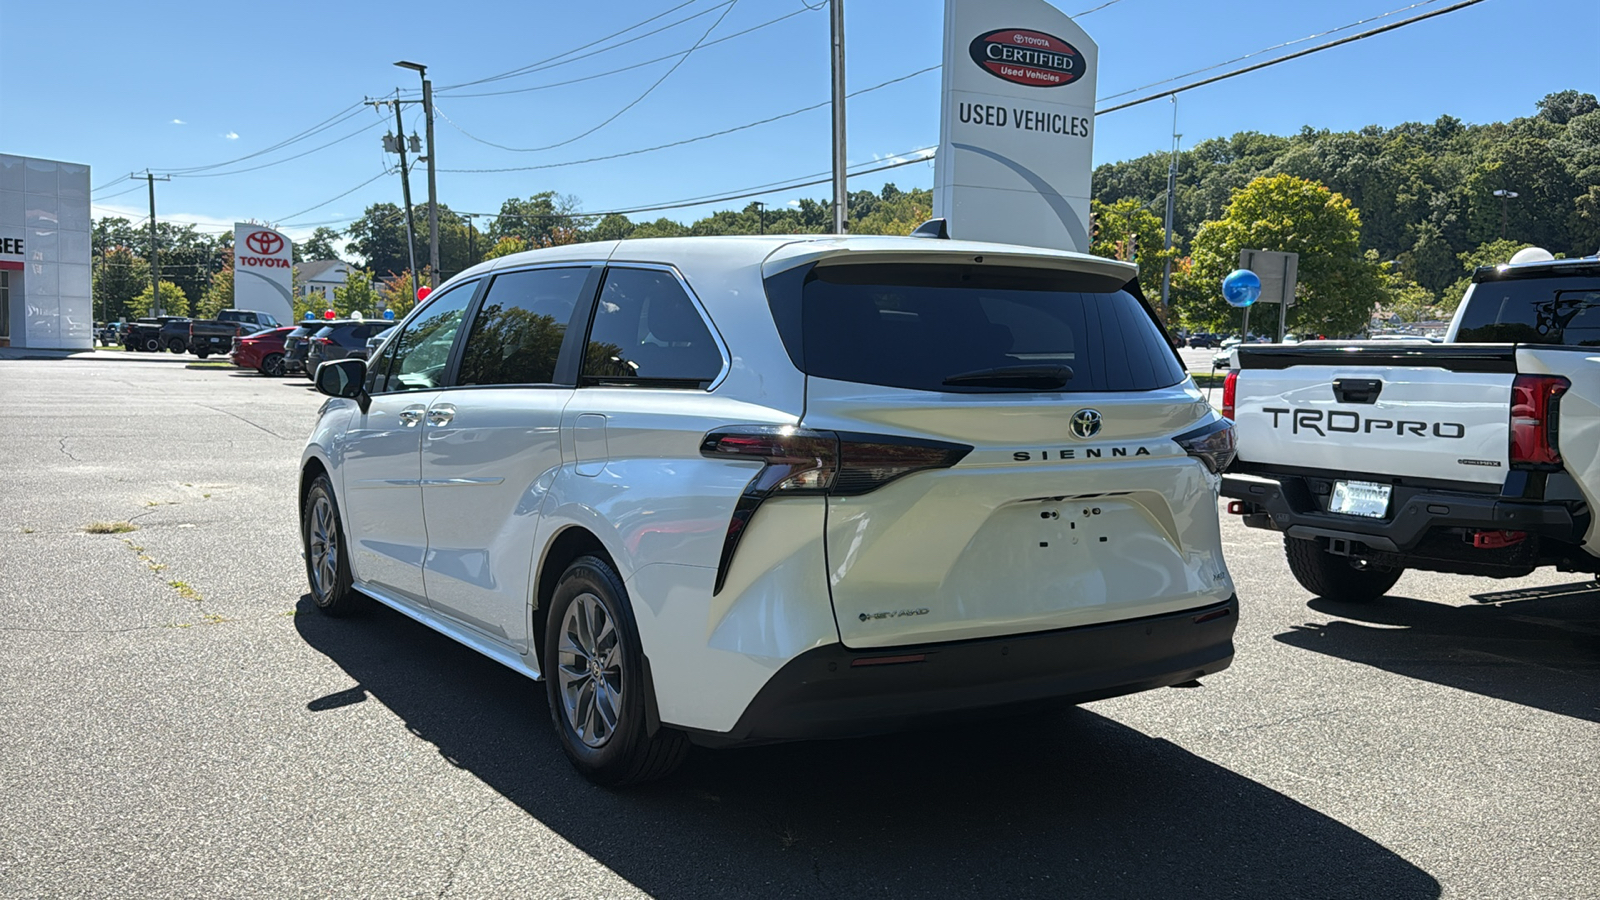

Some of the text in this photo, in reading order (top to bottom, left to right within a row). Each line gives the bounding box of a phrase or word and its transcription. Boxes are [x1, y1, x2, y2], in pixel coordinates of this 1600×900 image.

[1024, 36, 1050, 47] TOYOTA
[986, 42, 1074, 70] CERTIFIED
[1001, 66, 1060, 82] Used Vehicles
[959, 102, 1089, 138] USED VEHICLES
[0, 237, 24, 255] EE
[239, 256, 291, 269] TOYOTA
[1013, 446, 1151, 462] SIENNA
